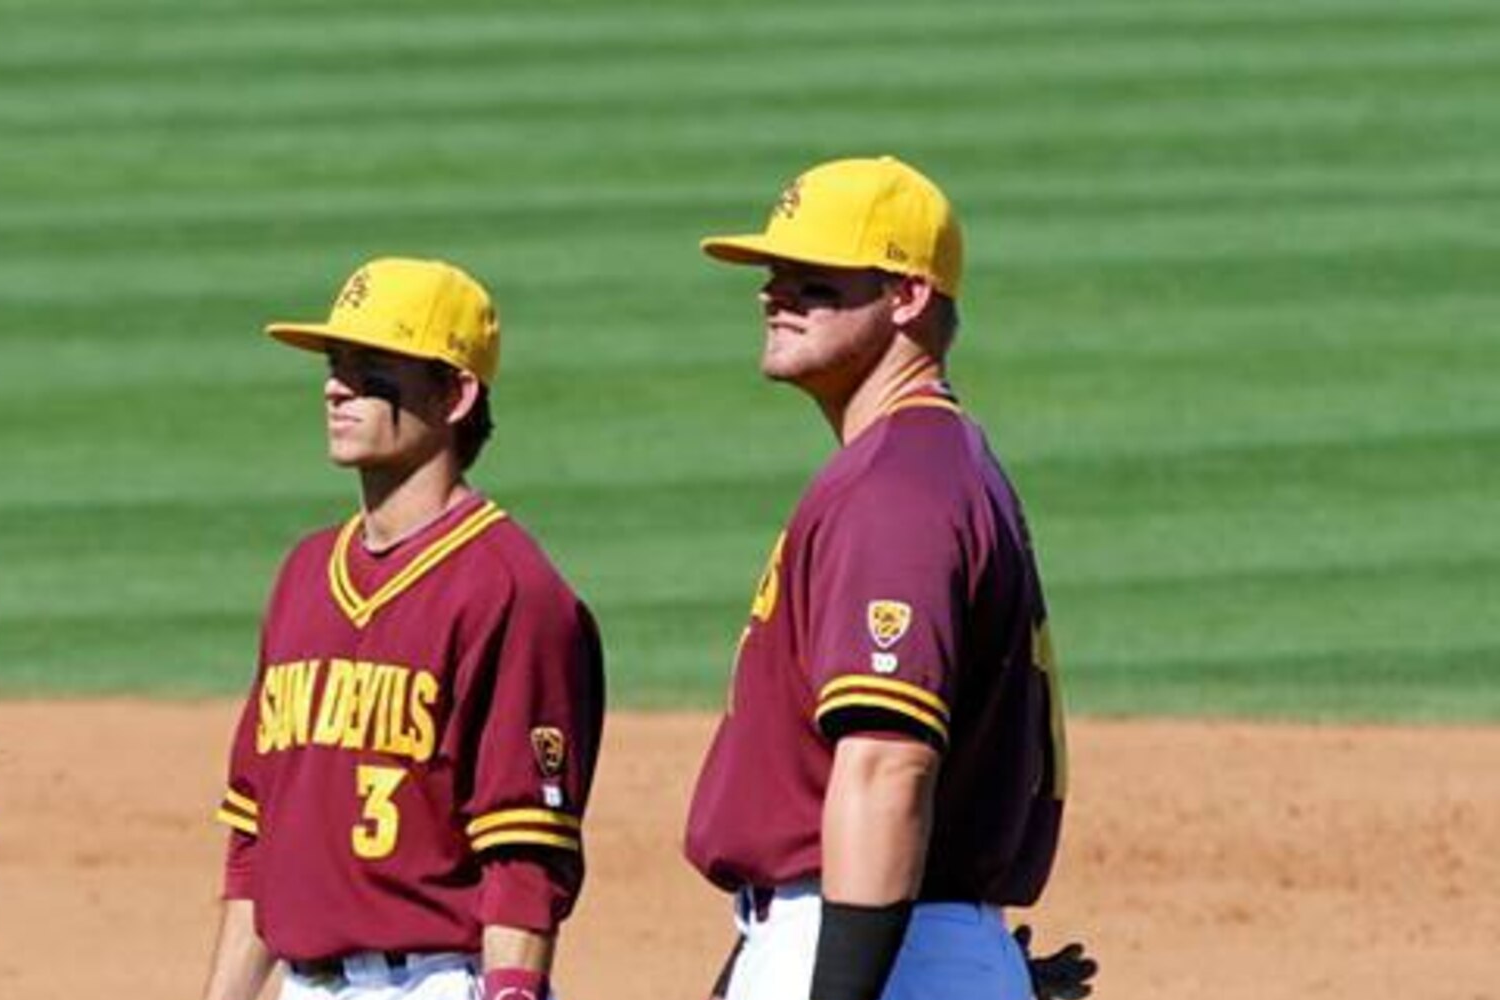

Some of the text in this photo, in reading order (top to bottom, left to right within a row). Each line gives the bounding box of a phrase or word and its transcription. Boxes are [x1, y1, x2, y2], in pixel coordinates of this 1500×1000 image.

[256, 658, 439, 763] SUN DEVILS
[351, 763, 409, 861] 3
